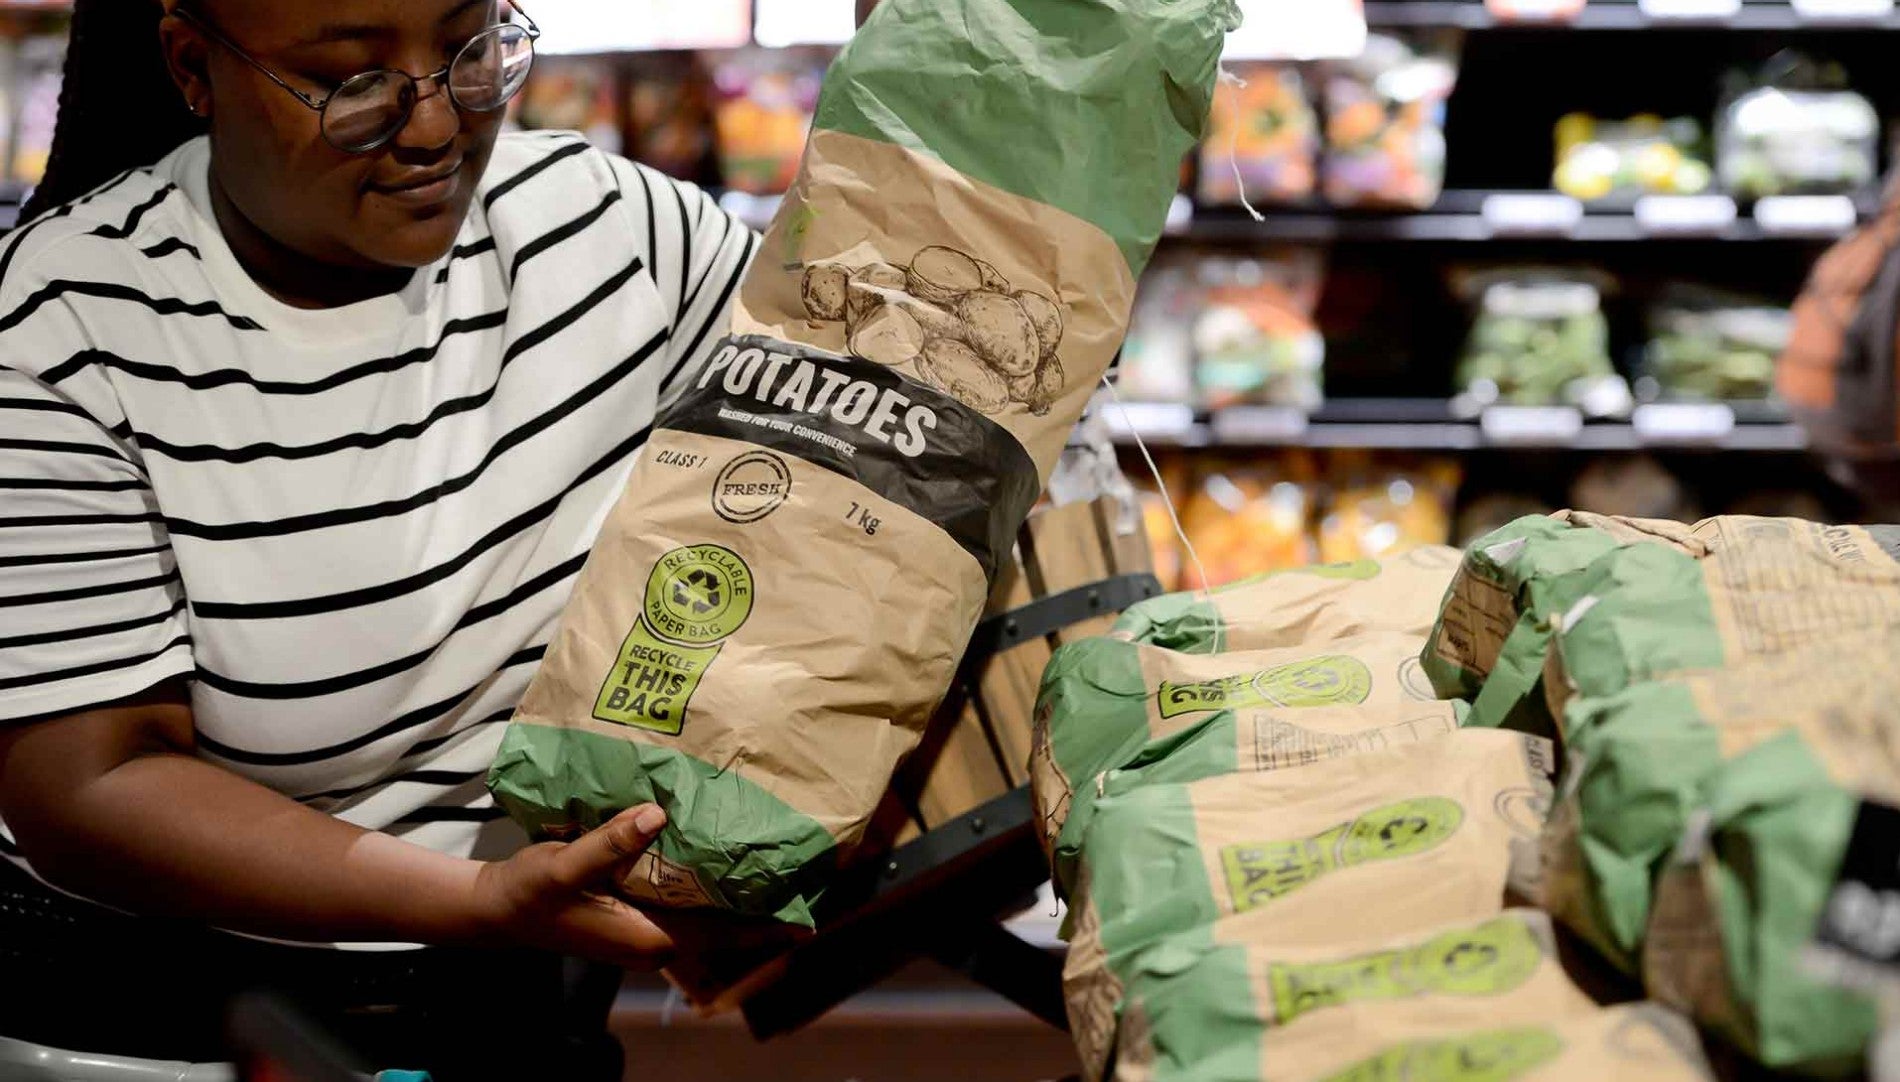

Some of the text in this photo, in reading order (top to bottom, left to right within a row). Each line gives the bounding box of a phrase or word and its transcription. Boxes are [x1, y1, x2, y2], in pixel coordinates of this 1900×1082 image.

[697, 345, 937, 457] POTATOES
[793, 424, 858, 458] CONVENIENCE
[656, 450, 697, 468] CLASS
[722, 483, 783, 496] FRESH
[845, 502, 882, 536] 7 kg
[664, 550, 747, 596] RECYCLABLE
[650, 600, 722, 638] PAPER BAG
[629, 645, 695, 672] RECYCLE
[620, 661, 687, 696] THIS
[606, 687, 671, 721] BAG
